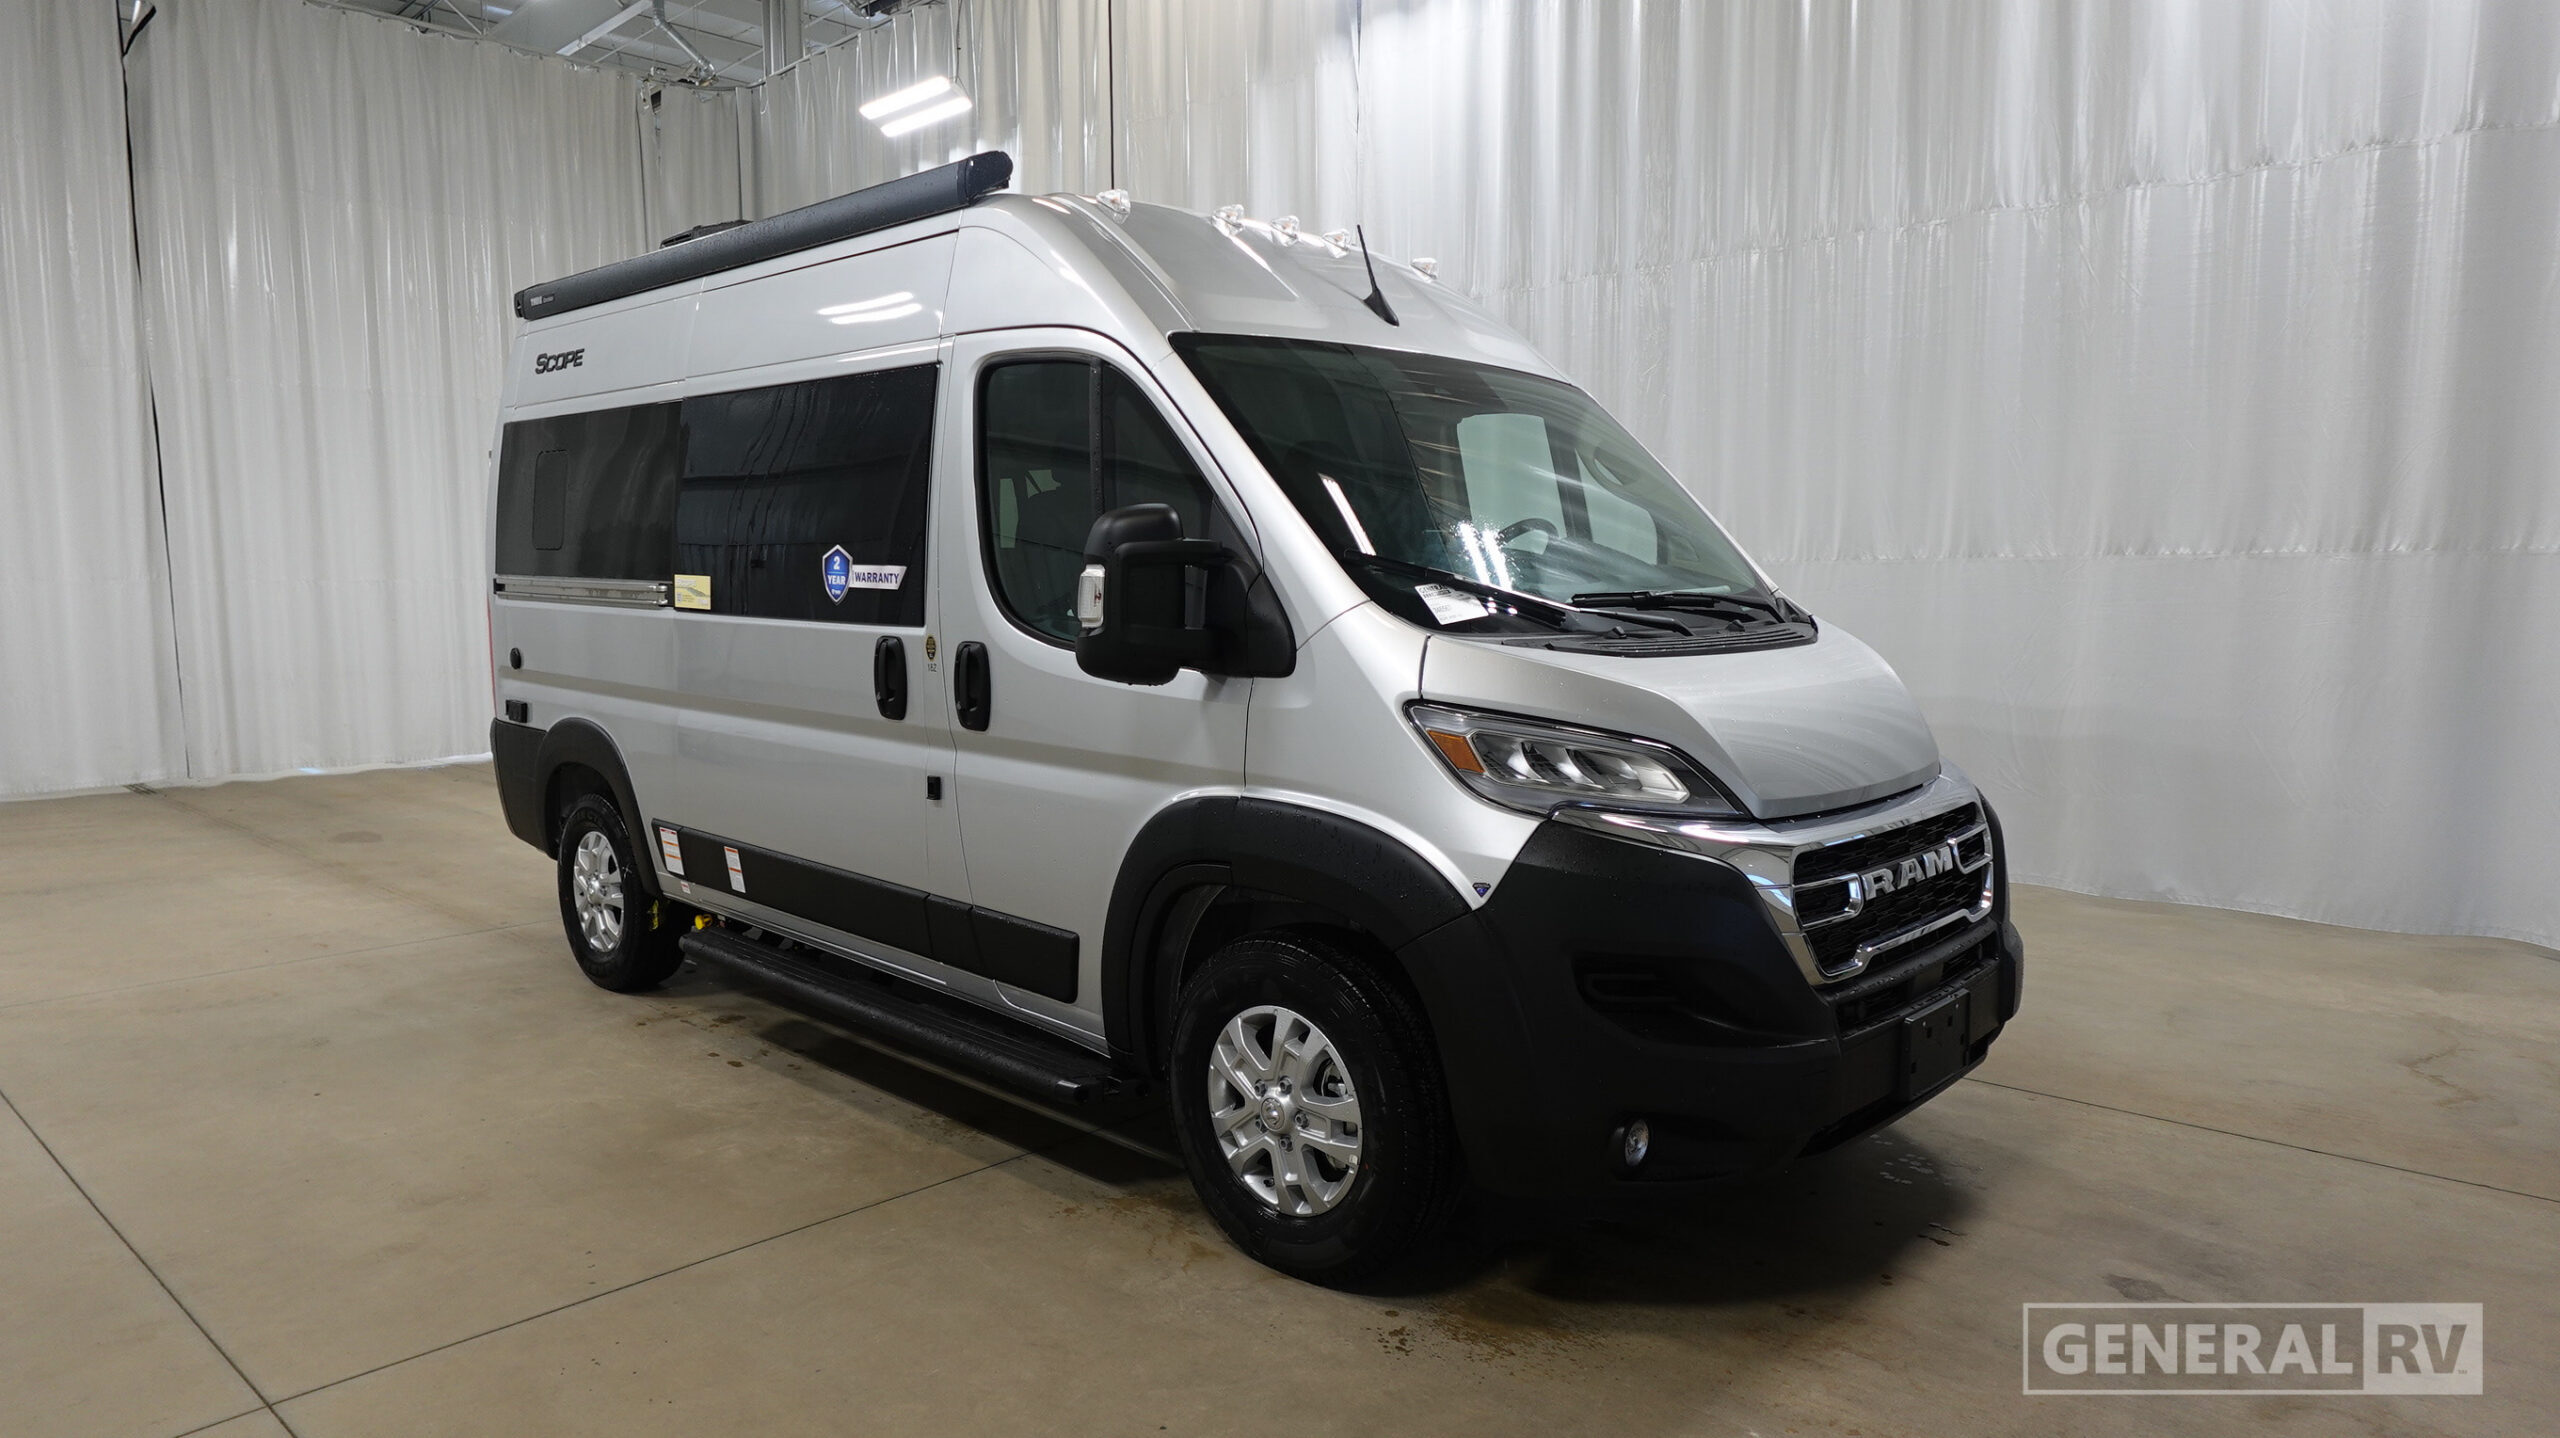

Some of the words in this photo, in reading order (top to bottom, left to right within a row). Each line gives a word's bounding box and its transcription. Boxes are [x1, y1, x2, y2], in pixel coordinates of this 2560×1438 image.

[535, 348, 585, 374] SCOPE
[833, 556, 841, 570] 2
[827, 575, 846, 585] YEAR
[854, 571, 900, 585] WARRANTY
[1861, 845, 1954, 901] RAM
